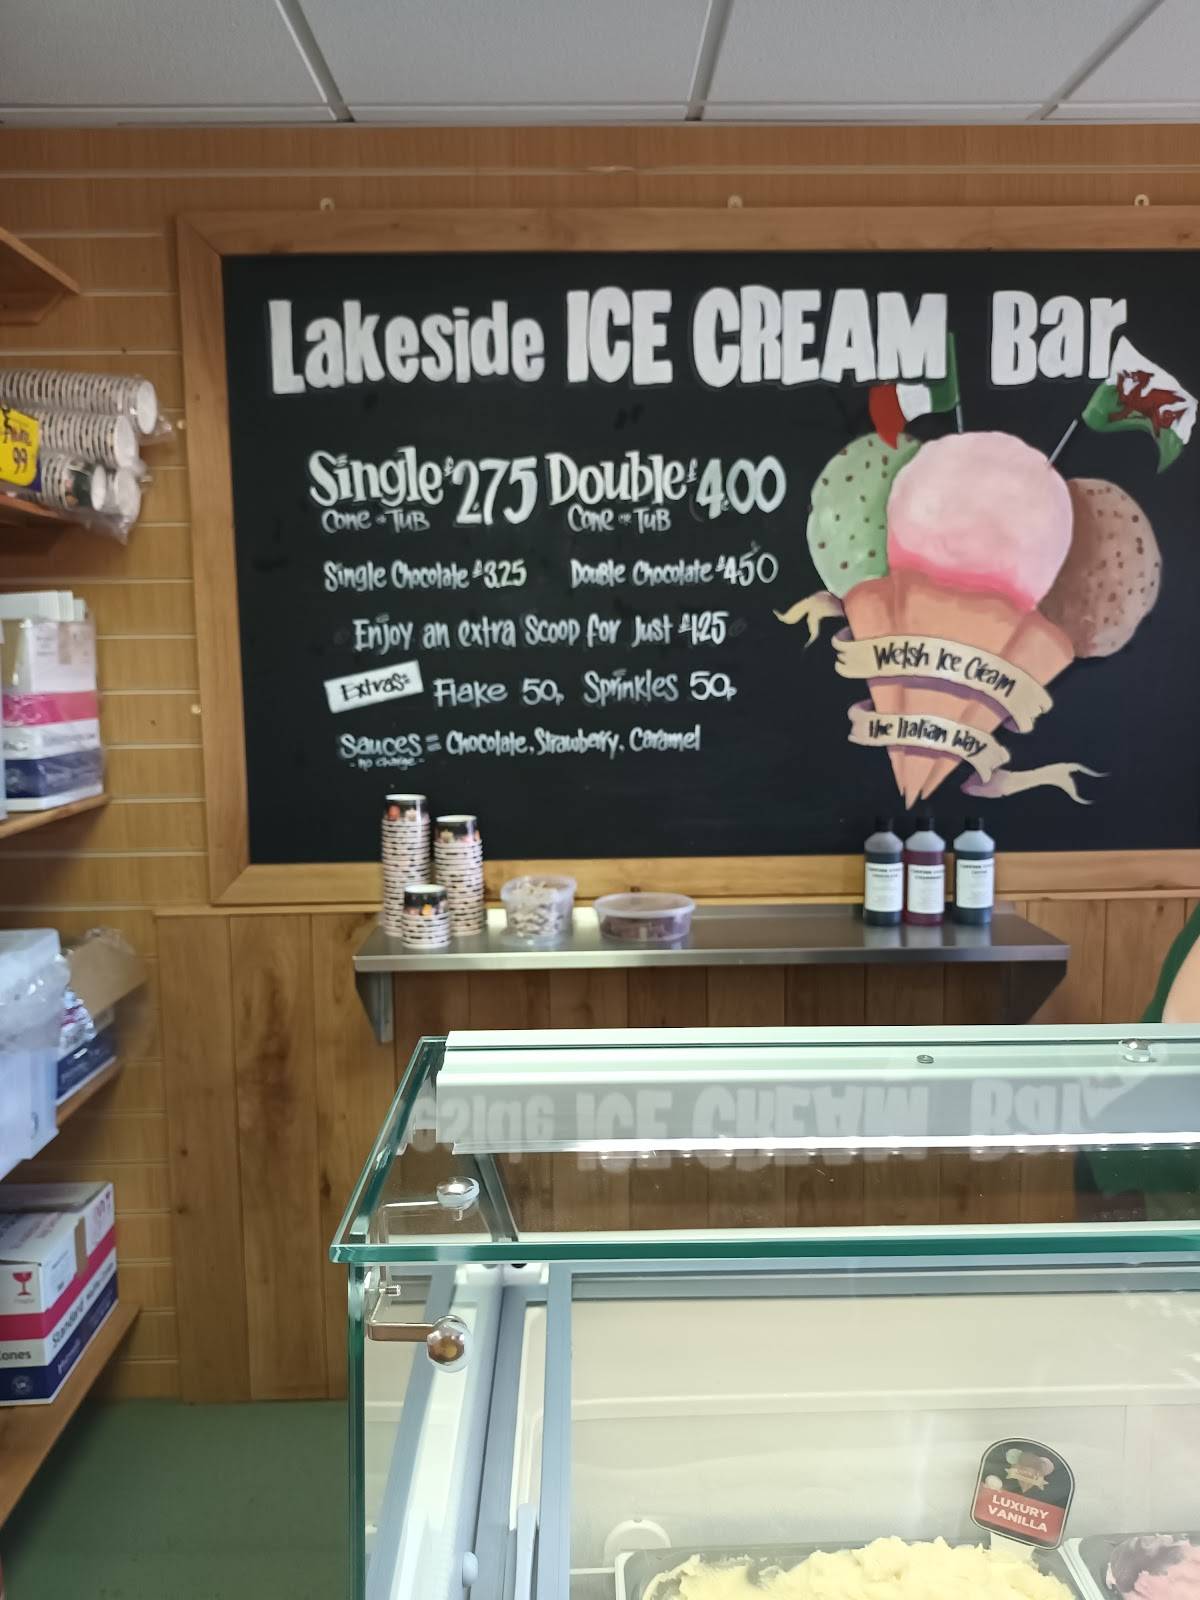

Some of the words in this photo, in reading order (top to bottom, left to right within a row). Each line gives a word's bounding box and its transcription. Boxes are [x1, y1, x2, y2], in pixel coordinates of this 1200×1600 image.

[268, 299, 545, 395] Lakeside
[566, 286, 673, 385] ICE
[693, 284, 948, 388] CREAM
[990, 290, 1127, 386] Bar
[308, 445, 444, 507] Single
[545, 450, 688, 507] Double
[321, 509, 372, 534] Cone
[567, 503, 614, 532] Cone
[323, 560, 387, 592] Single
[391, 559, 470, 590] Chocolate
[632, 559, 714, 586] Chocolate
[352, 613, 414, 655] Enjoy
[422, 621, 450, 649] an
[457, 615, 517, 648] extra
[873, 641, 929, 671] Welsh
[936, 647, 962, 673] Ice
[964, 655, 1016, 698] Cream
[433, 677, 509, 708] Flake
[522, 678, 565, 706] 50p
[583, 668, 679, 707] Sprinkles
[689, 670, 737, 701] 50p
[339, 732, 423, 759] Sauces
[629, 724, 701, 752] Caramel
[899, 717, 947, 744] Italian
[0, 1350, 32, 1361] ones
[987, 1504, 1048, 1533] VANILLA
[992, 1494, 1049, 1520] LUXURY
